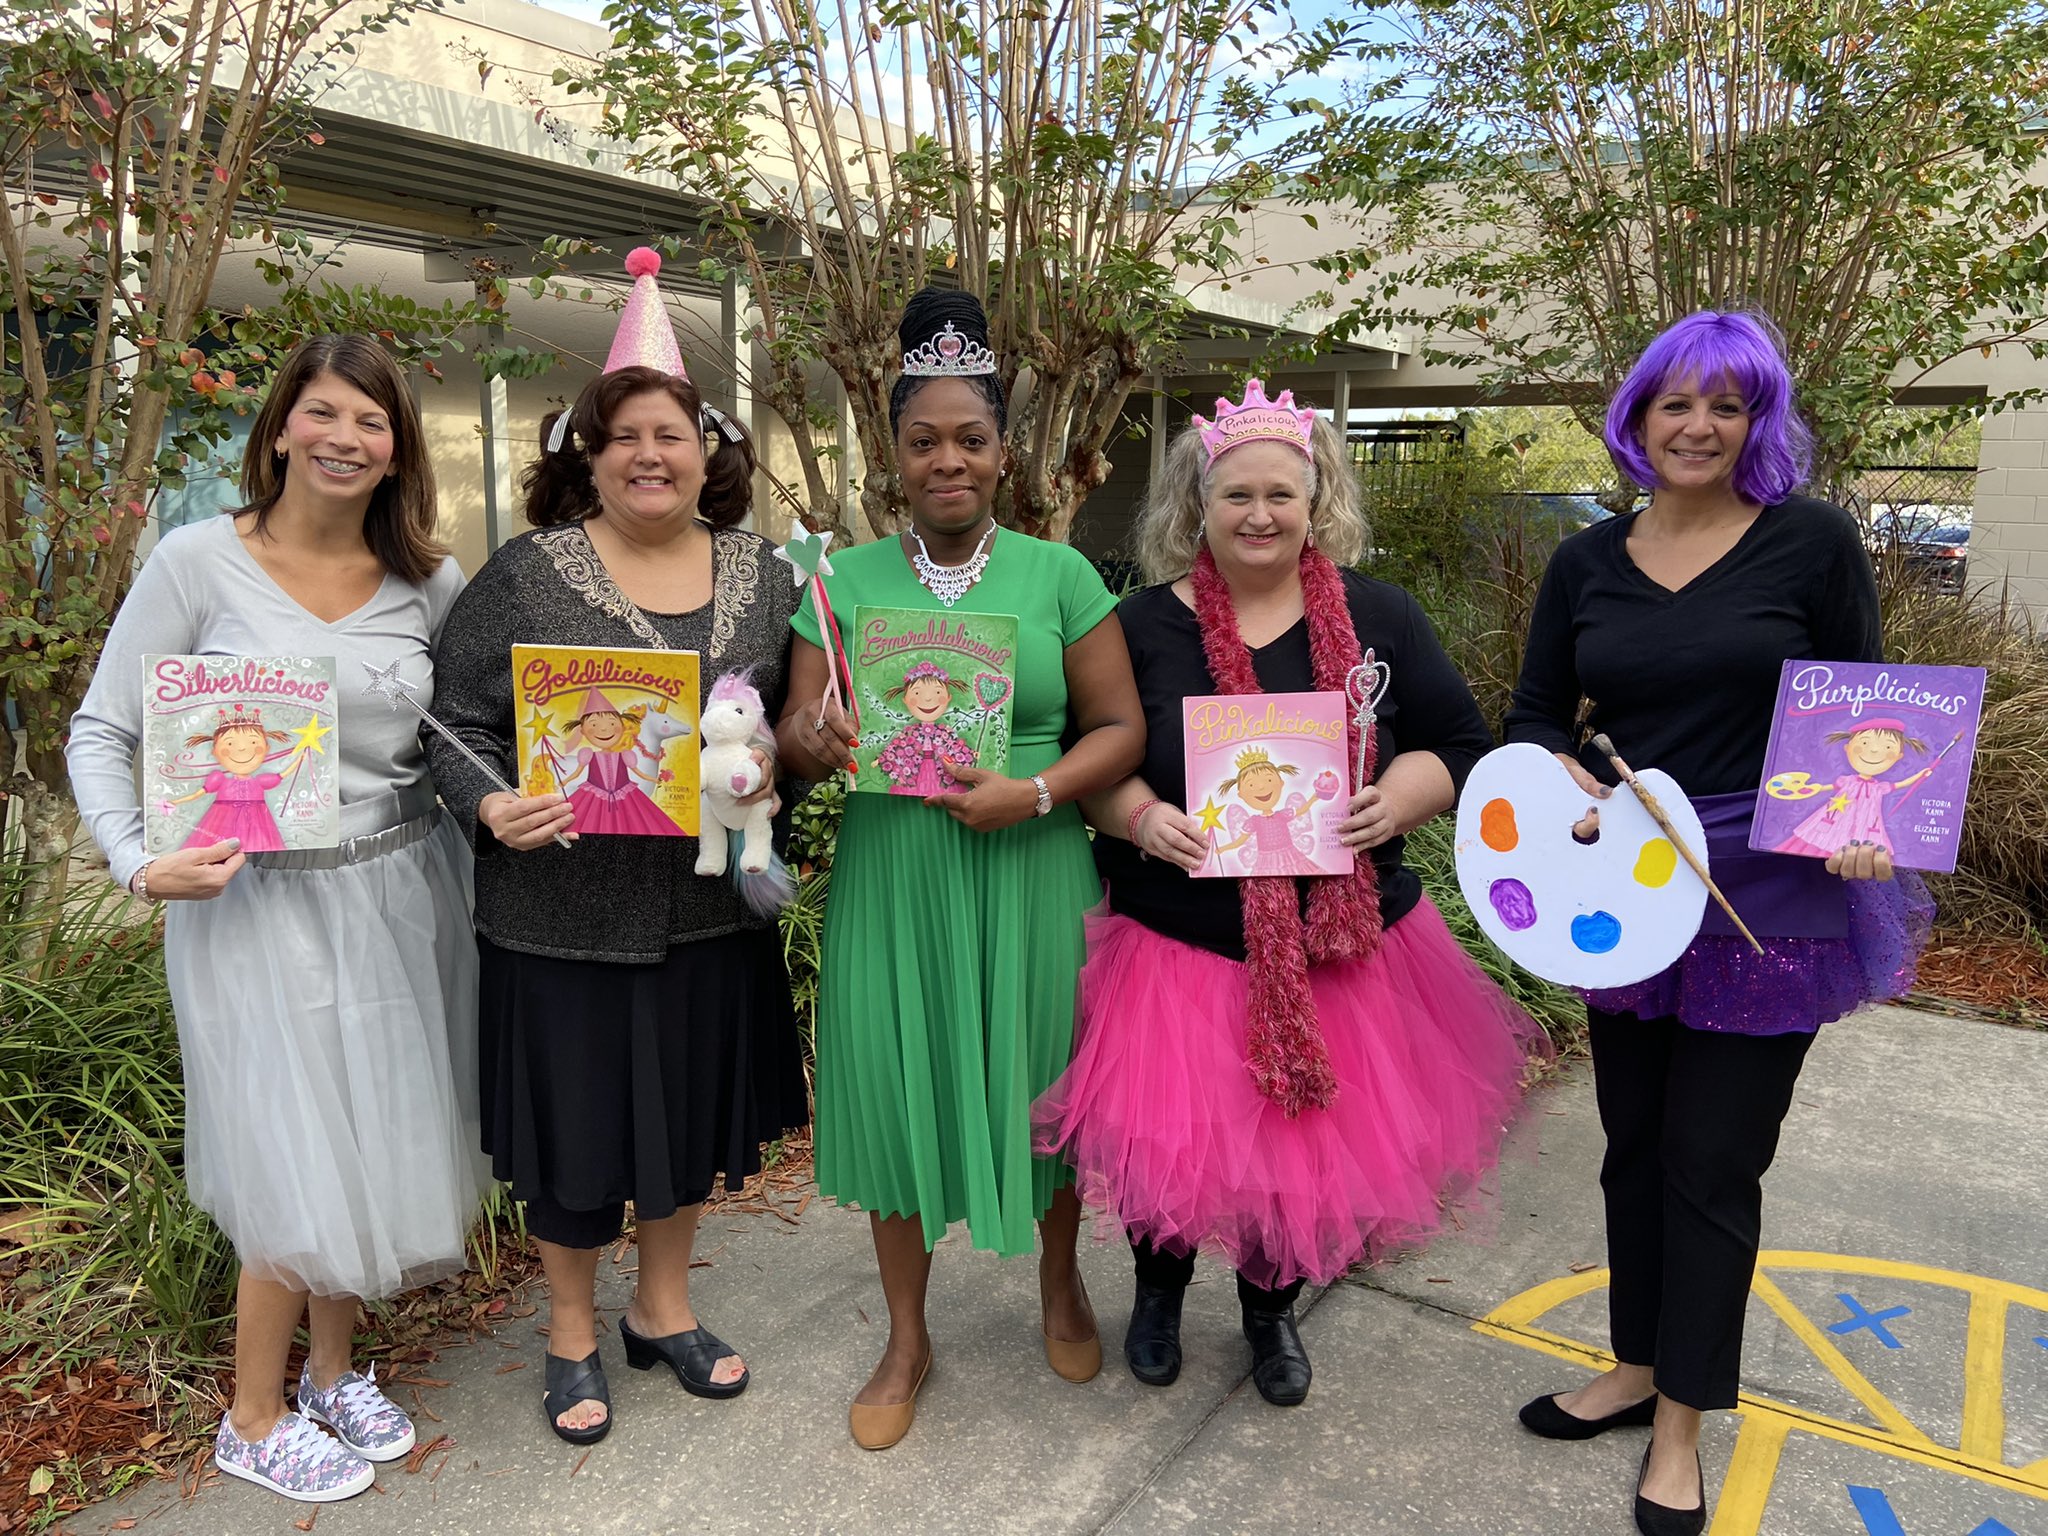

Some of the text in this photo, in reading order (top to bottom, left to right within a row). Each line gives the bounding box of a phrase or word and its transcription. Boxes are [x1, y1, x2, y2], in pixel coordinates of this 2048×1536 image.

[1224, 413, 1297, 430] Pinkalicious
[864, 619, 1012, 666] Emeraldalicious
[155, 659, 330, 702] Silverlicious
[522, 658, 685, 706] Goldilicious
[1792, 665, 1967, 717] Purplicious
[1190, 702, 1344, 748] Pinkalicious
[1921, 798, 1951, 808] VICTORIA
[1925, 808, 1944, 817] KANN
[1913, 824, 1950, 835] ELIZABETH
[1920, 834, 1940, 843] KANN
